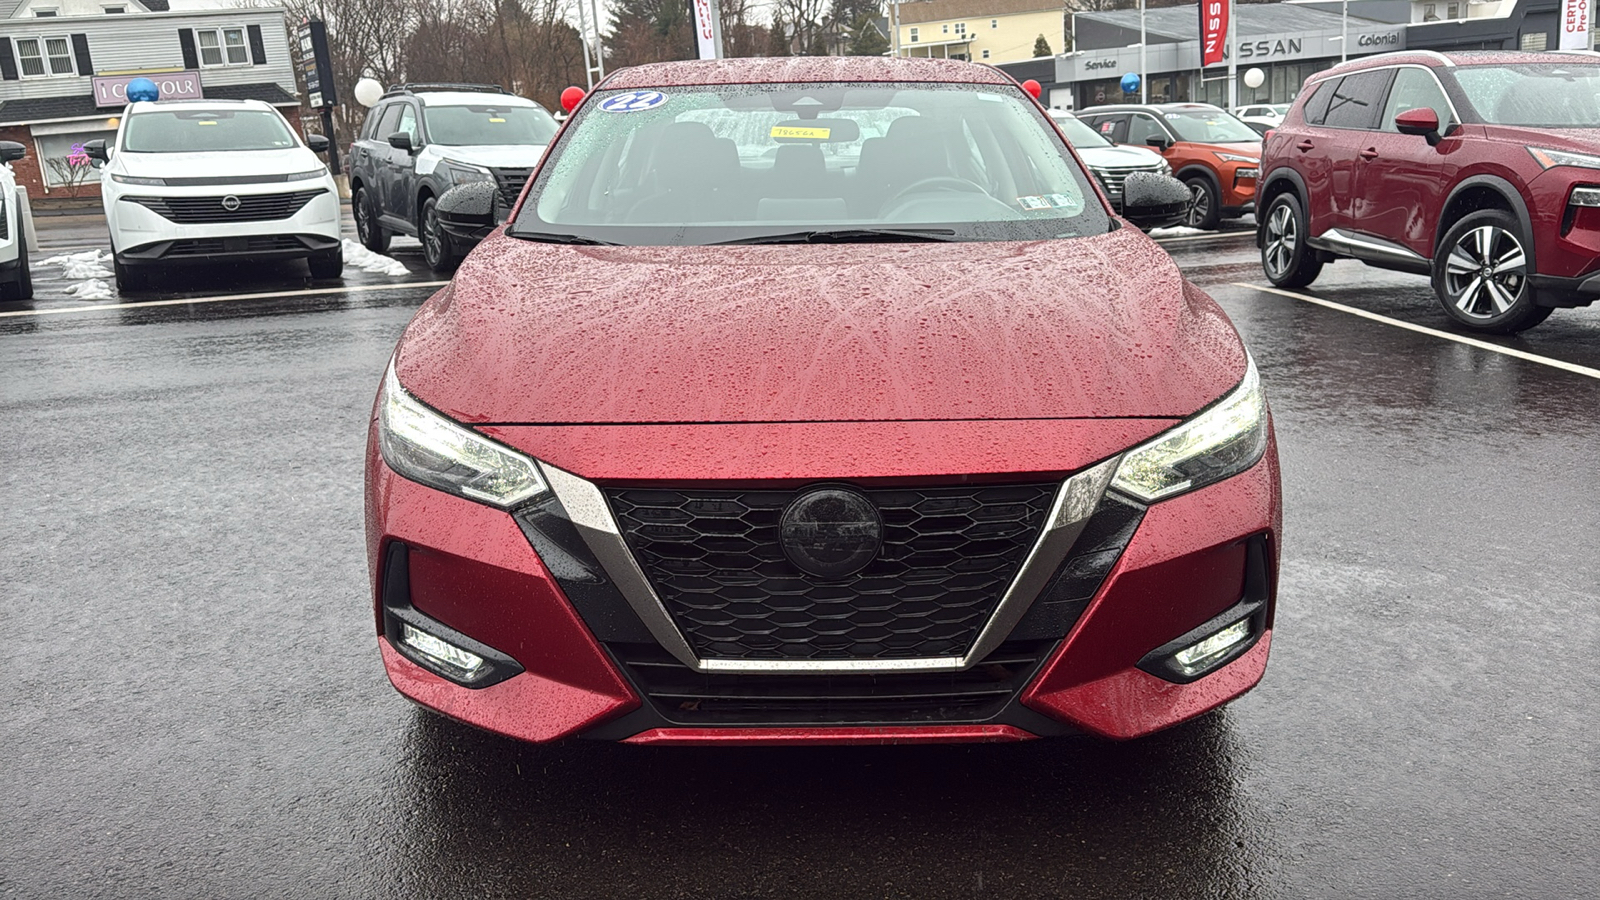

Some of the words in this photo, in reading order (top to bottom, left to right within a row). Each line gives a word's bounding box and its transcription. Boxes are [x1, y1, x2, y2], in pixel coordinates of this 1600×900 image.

[1577, 0, 1587, 32] Pre-O
[1205, 2, 1221, 53] NISS
[1358, 31, 1400, 47] Colonial
[1222, 38, 1302, 60] NSSAN
[1085, 58, 1117, 71] Service
[111, 80, 195, 98] COUR
[605, 93, 660, 110] 22
